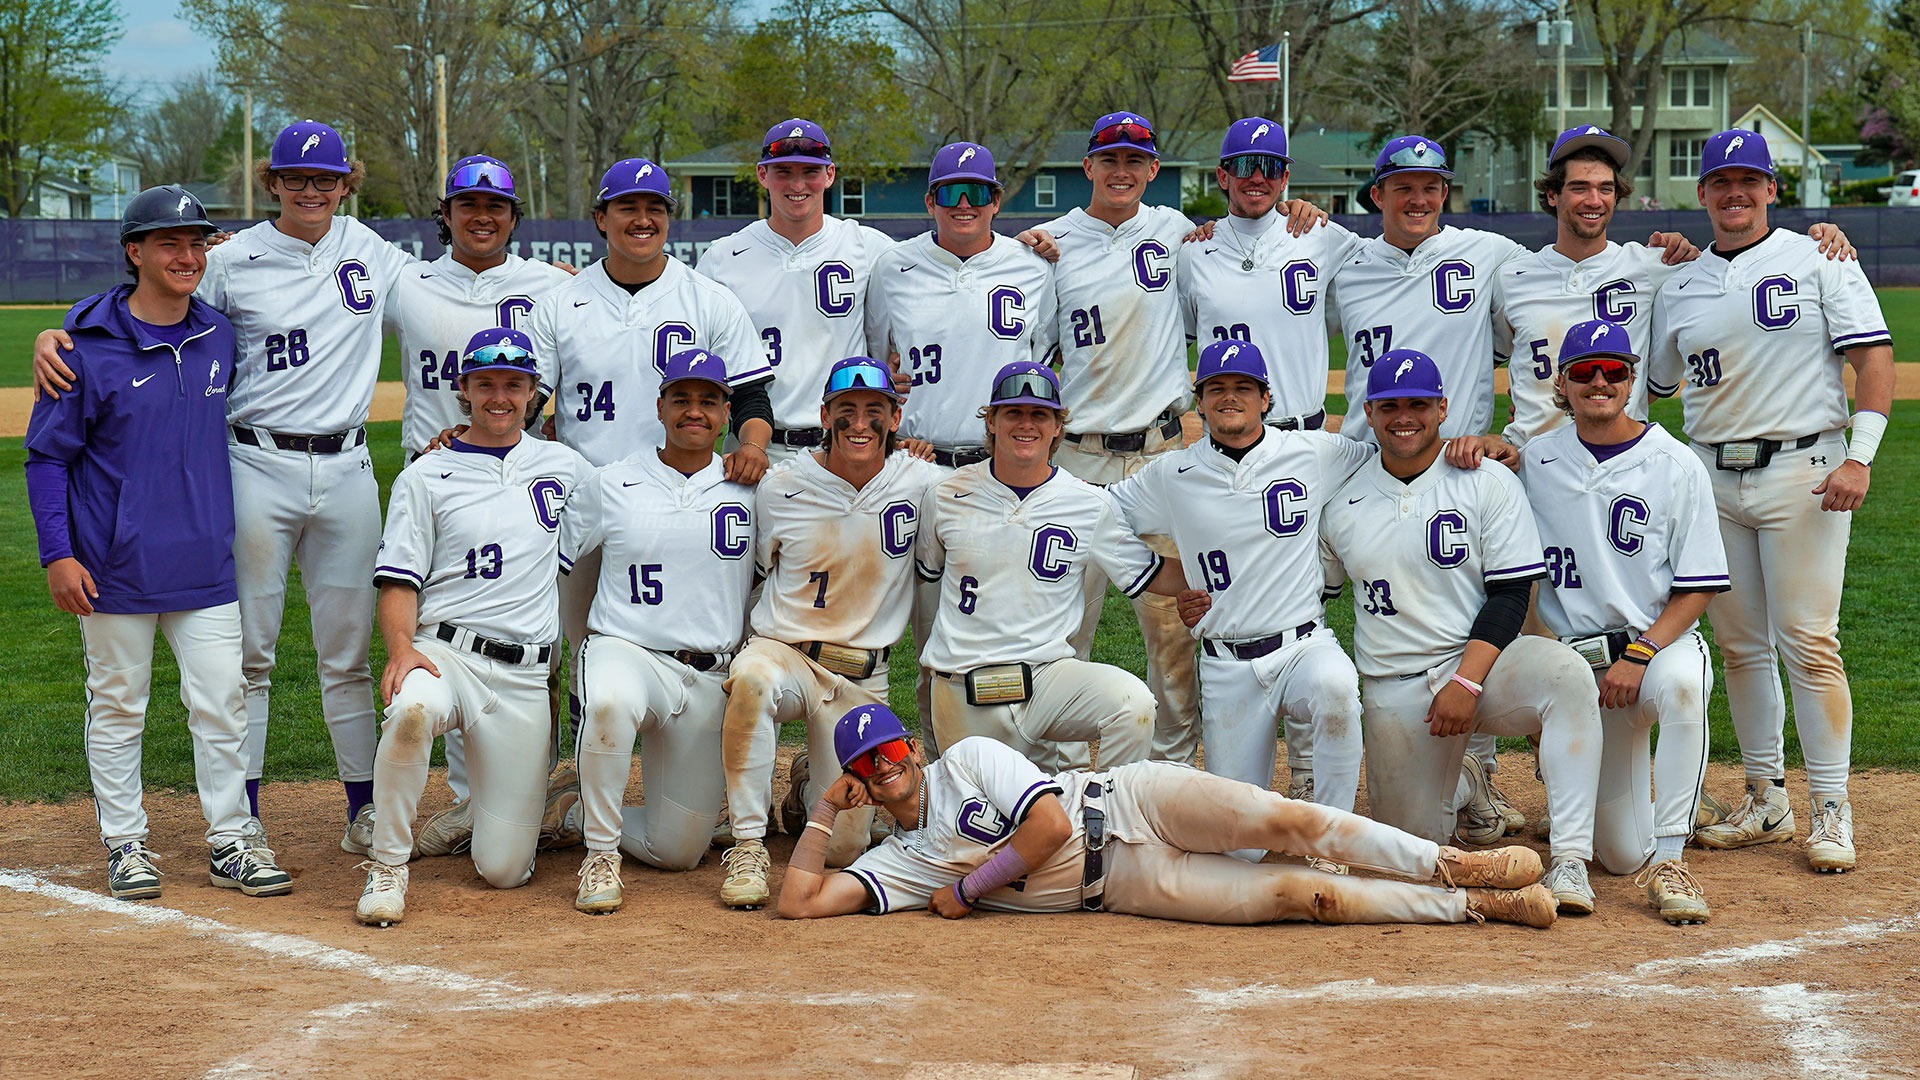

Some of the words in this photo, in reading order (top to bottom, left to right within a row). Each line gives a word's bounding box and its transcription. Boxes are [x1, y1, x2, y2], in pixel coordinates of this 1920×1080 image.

[334, 259, 375, 315] C
[814, 260, 856, 318] C
[1132, 239, 1172, 293] C
[1280, 258, 1319, 316] C
[1431, 259, 1476, 315] C
[987, 284, 1026, 341] C
[1070, 305, 1107, 349] 21
[1592, 278, 1638, 327] C
[1751, 273, 1801, 332] C
[264, 328, 310, 373] 28
[419, 350, 460, 391] 24
[908, 343, 943, 387] 23
[1354, 324, 1394, 369] 37
[1529, 338, 1553, 381] 5
[1687, 347, 1723, 388] 30
[576, 380, 616, 422] 34
[528, 476, 566, 533] C
[878, 499, 917, 559] C
[1261, 477, 1308, 539] C
[1607, 493, 1651, 558] C
[710, 501, 751, 561] C
[1028, 522, 1079, 583] C
[1425, 508, 1470, 570] C
[463, 542, 504, 580] 13
[628, 563, 663, 606] 15
[1198, 550, 1232, 593] 19
[1543, 546, 1583, 589] 32
[809, 570, 830, 609] 7
[958, 575, 979, 616] 6
[1362, 578, 1399, 617] 33
[956, 796, 1017, 848] C
